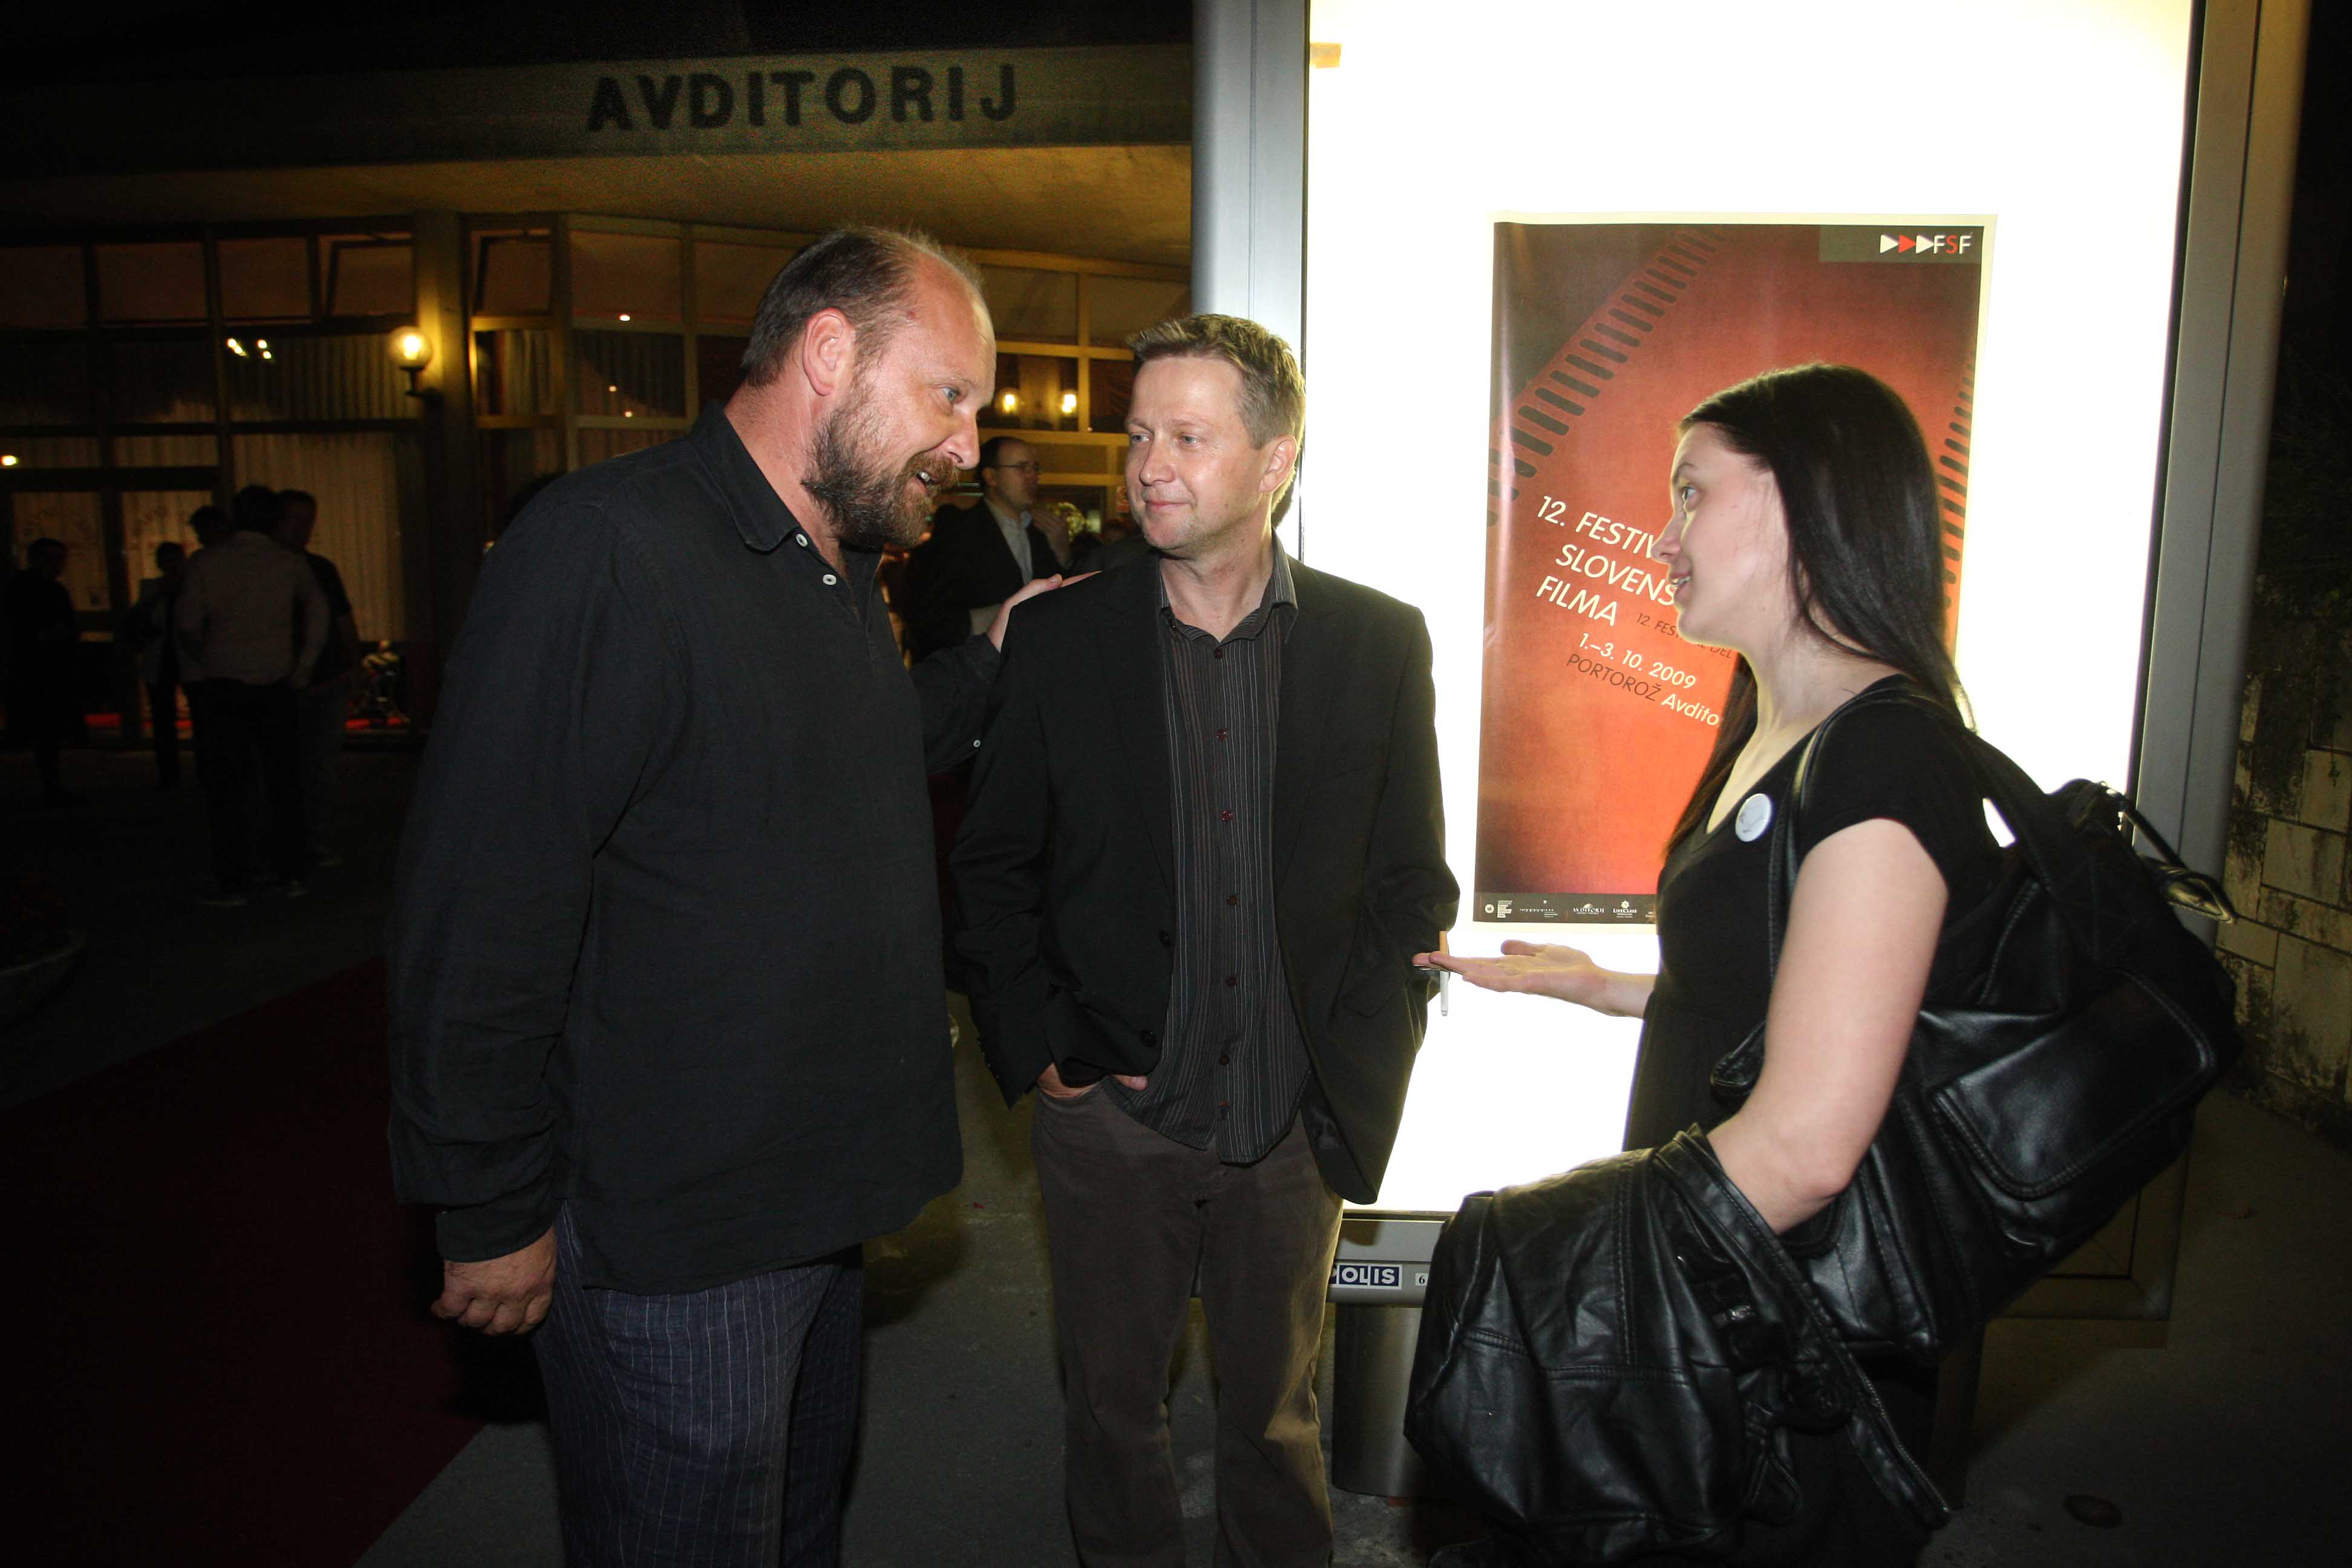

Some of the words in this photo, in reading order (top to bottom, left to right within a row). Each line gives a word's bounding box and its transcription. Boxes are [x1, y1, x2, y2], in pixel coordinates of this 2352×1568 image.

[586, 63, 1016, 131] AVDITORIJ
[1933, 235, 1971, 254] FSF
[1537, 495, 1566, 527] 12.
[1535, 575, 1618, 626] FILMA
[1636, 613, 1650, 627] 12.
[1566, 653, 1662, 702] PORTOROŽ
[1661, 693, 1719, 726] Avdito
[1622, 650, 1643, 671] 10.
[1648, 662, 1696, 690] 2009
